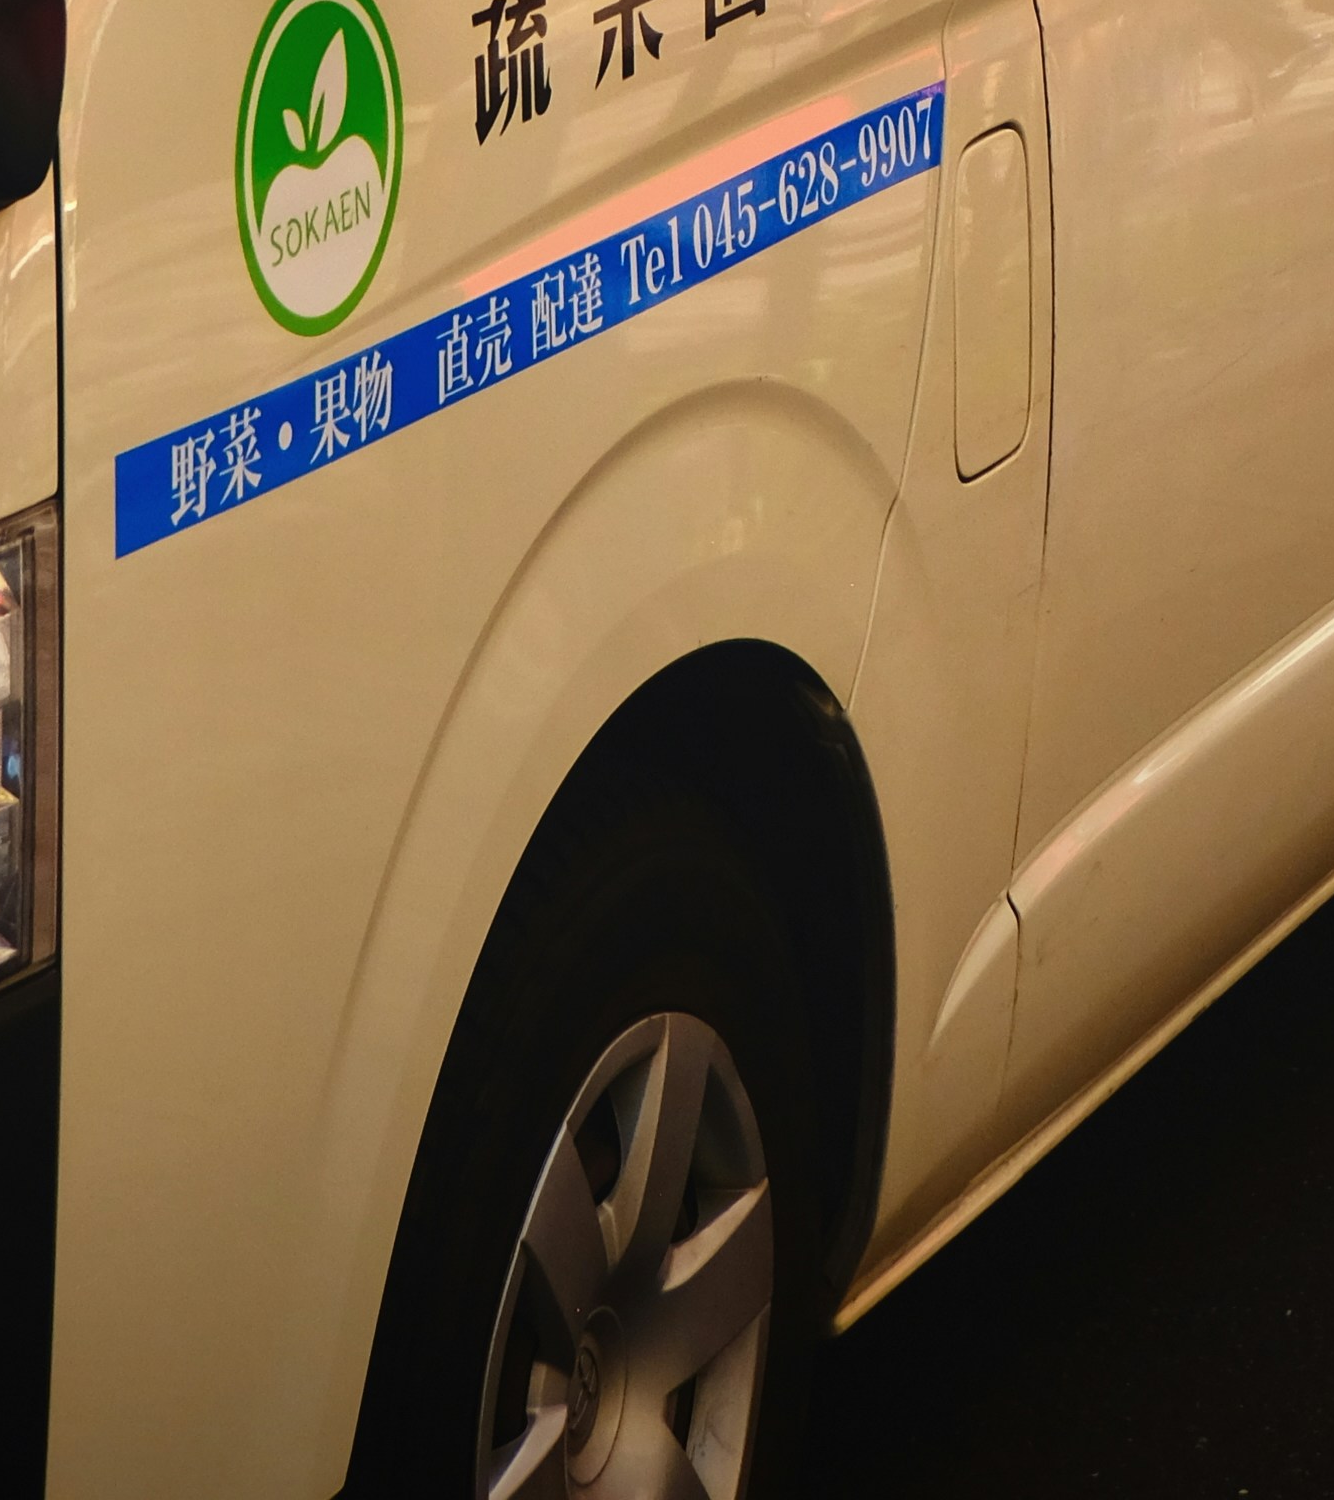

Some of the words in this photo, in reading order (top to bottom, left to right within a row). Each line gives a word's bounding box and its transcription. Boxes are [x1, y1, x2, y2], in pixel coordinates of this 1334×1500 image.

[170, 350, 394, 527] 野菜・果物
[436, 295, 513, 406] 直売
[531, 251, 605, 360] 配達
[619, 214, 685, 308] Tel
[691, 96, 937, 271] 045-628-9907
[269, 184, 373, 268] SOKAEN
